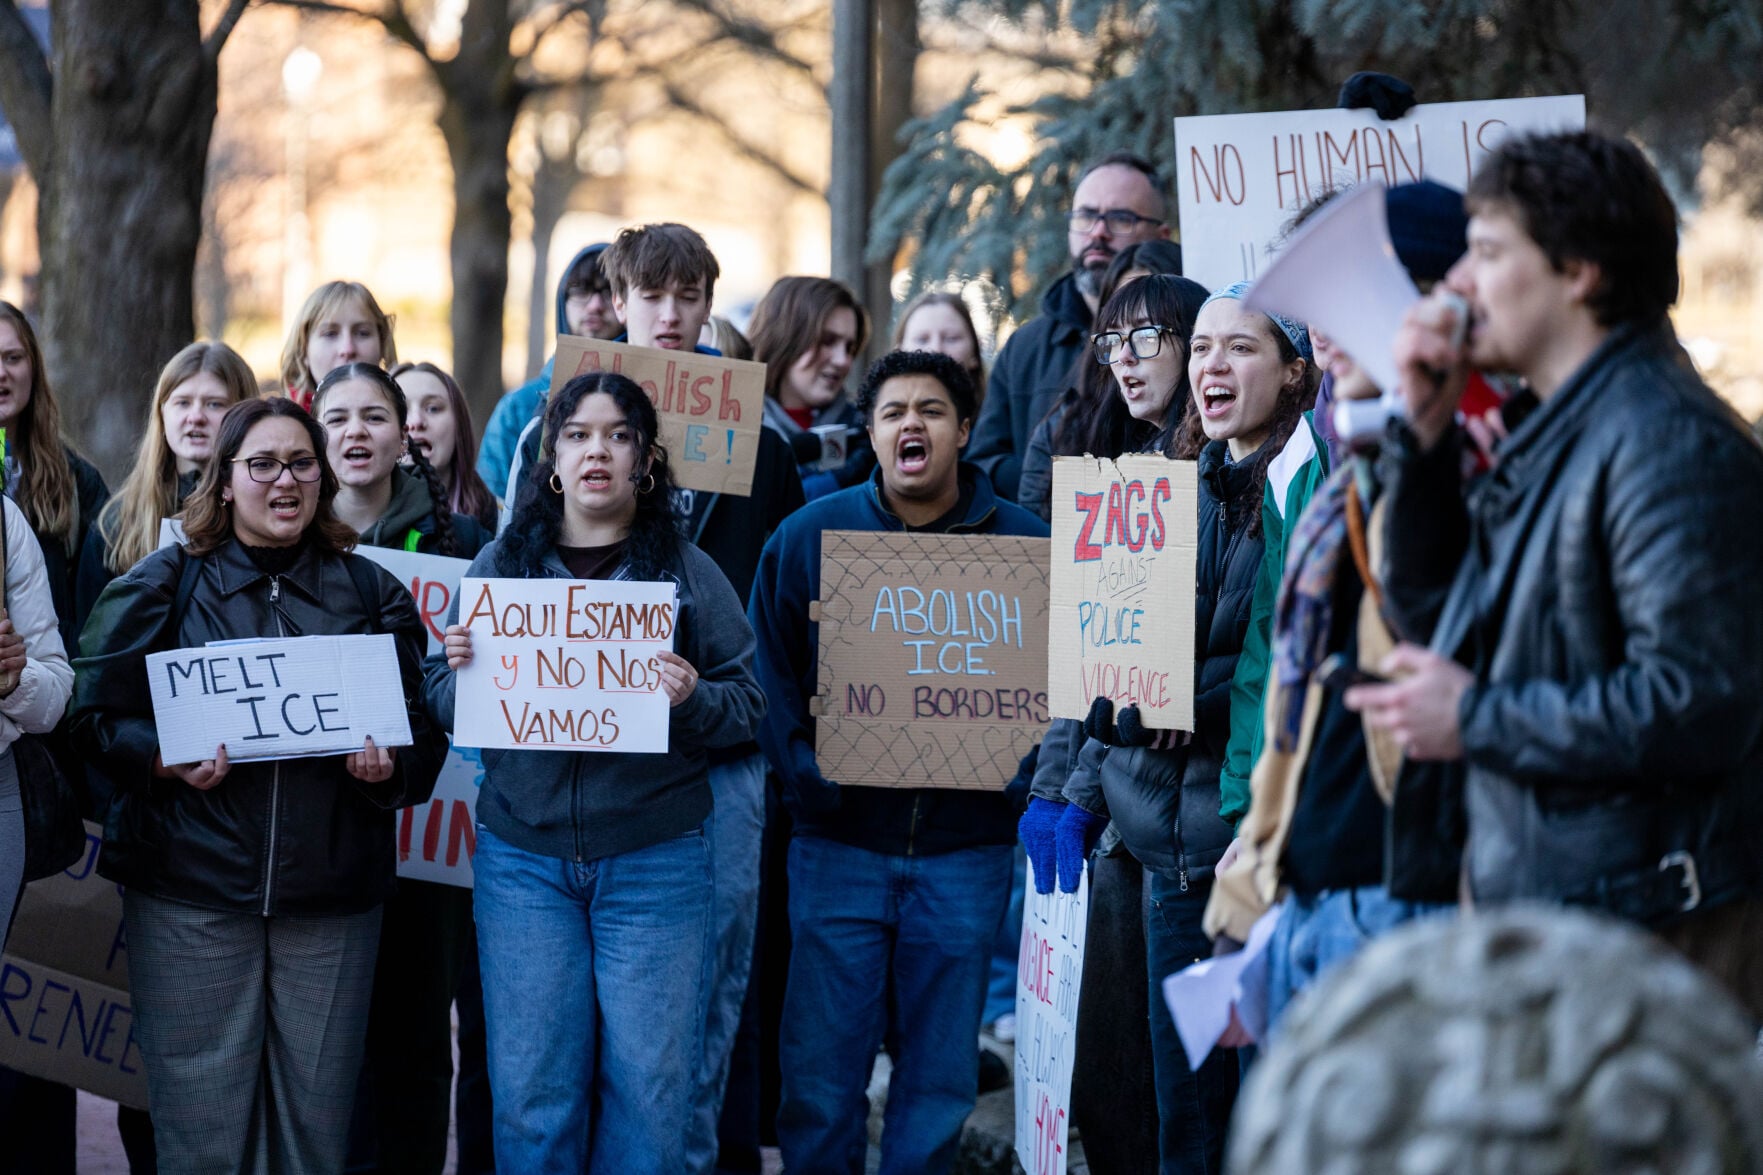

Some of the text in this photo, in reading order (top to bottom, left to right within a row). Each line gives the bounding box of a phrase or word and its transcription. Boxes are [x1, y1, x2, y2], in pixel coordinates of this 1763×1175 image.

[1190, 143, 1246, 207] NO
[1273, 124, 1424, 209] HUMAN
[1074, 477, 1171, 563] ZAGS
[1096, 556, 1156, 596] AGAINST
[466, 583, 559, 638] AQUI
[566, 585, 673, 640] ESTAMOS
[870, 585, 1023, 648] ABOLISH
[1078, 601, 1145, 658] POLICE
[166, 653, 286, 698] MELT
[536, 647, 586, 687] NO
[597, 649, 663, 691] NOS
[1081, 663, 1172, 709] VIOLENCE
[236, 693, 350, 740] ICE
[500, 700, 620, 745] VAMOS
[846, 683, 1049, 723] NO BORDERS
[0, 963, 138, 1074] RENEE
